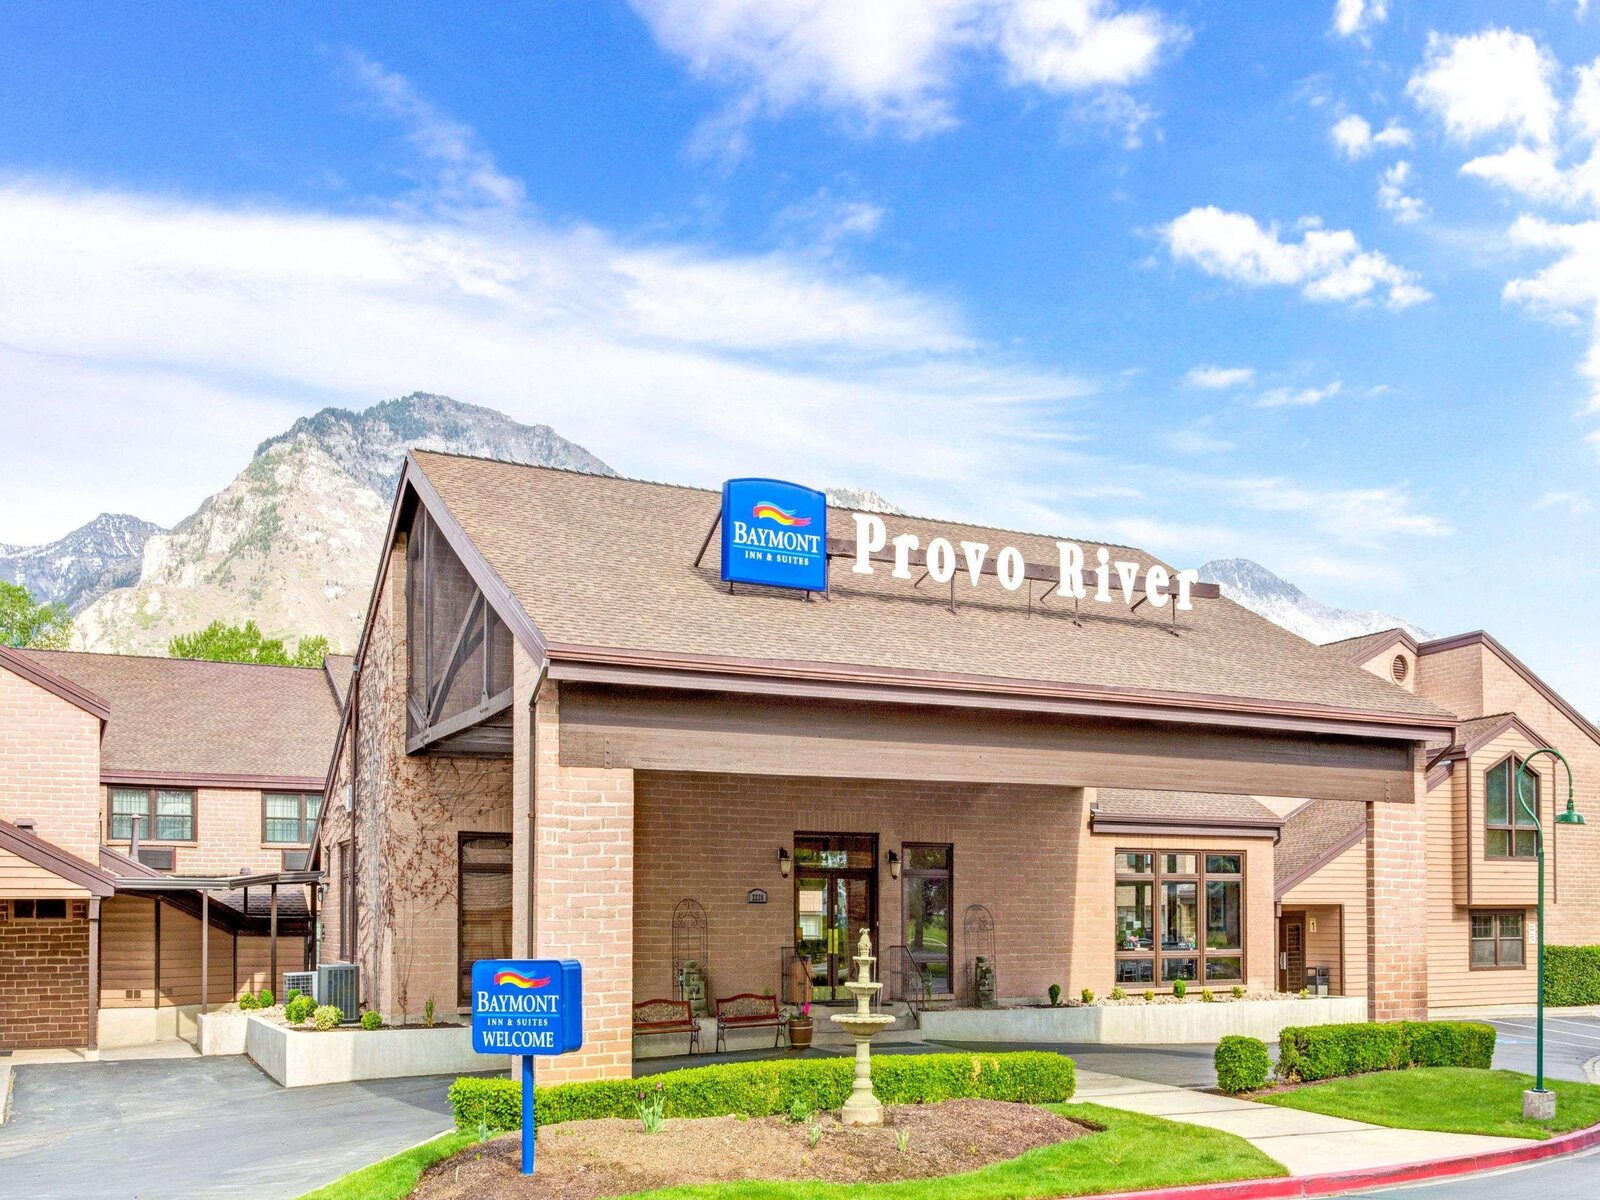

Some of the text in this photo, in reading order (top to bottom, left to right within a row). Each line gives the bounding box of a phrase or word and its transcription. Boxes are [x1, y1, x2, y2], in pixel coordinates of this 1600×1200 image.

[733, 521, 821, 554] BAYMONT
[745, 550, 809, 567] INN & SUITES
[851, 513, 1199, 611] Provo River
[476, 991, 560, 1013] BAYMONT
[487, 1018, 549, 1027] INN & SUITES
[482, 1031, 555, 1048] WELCOME
